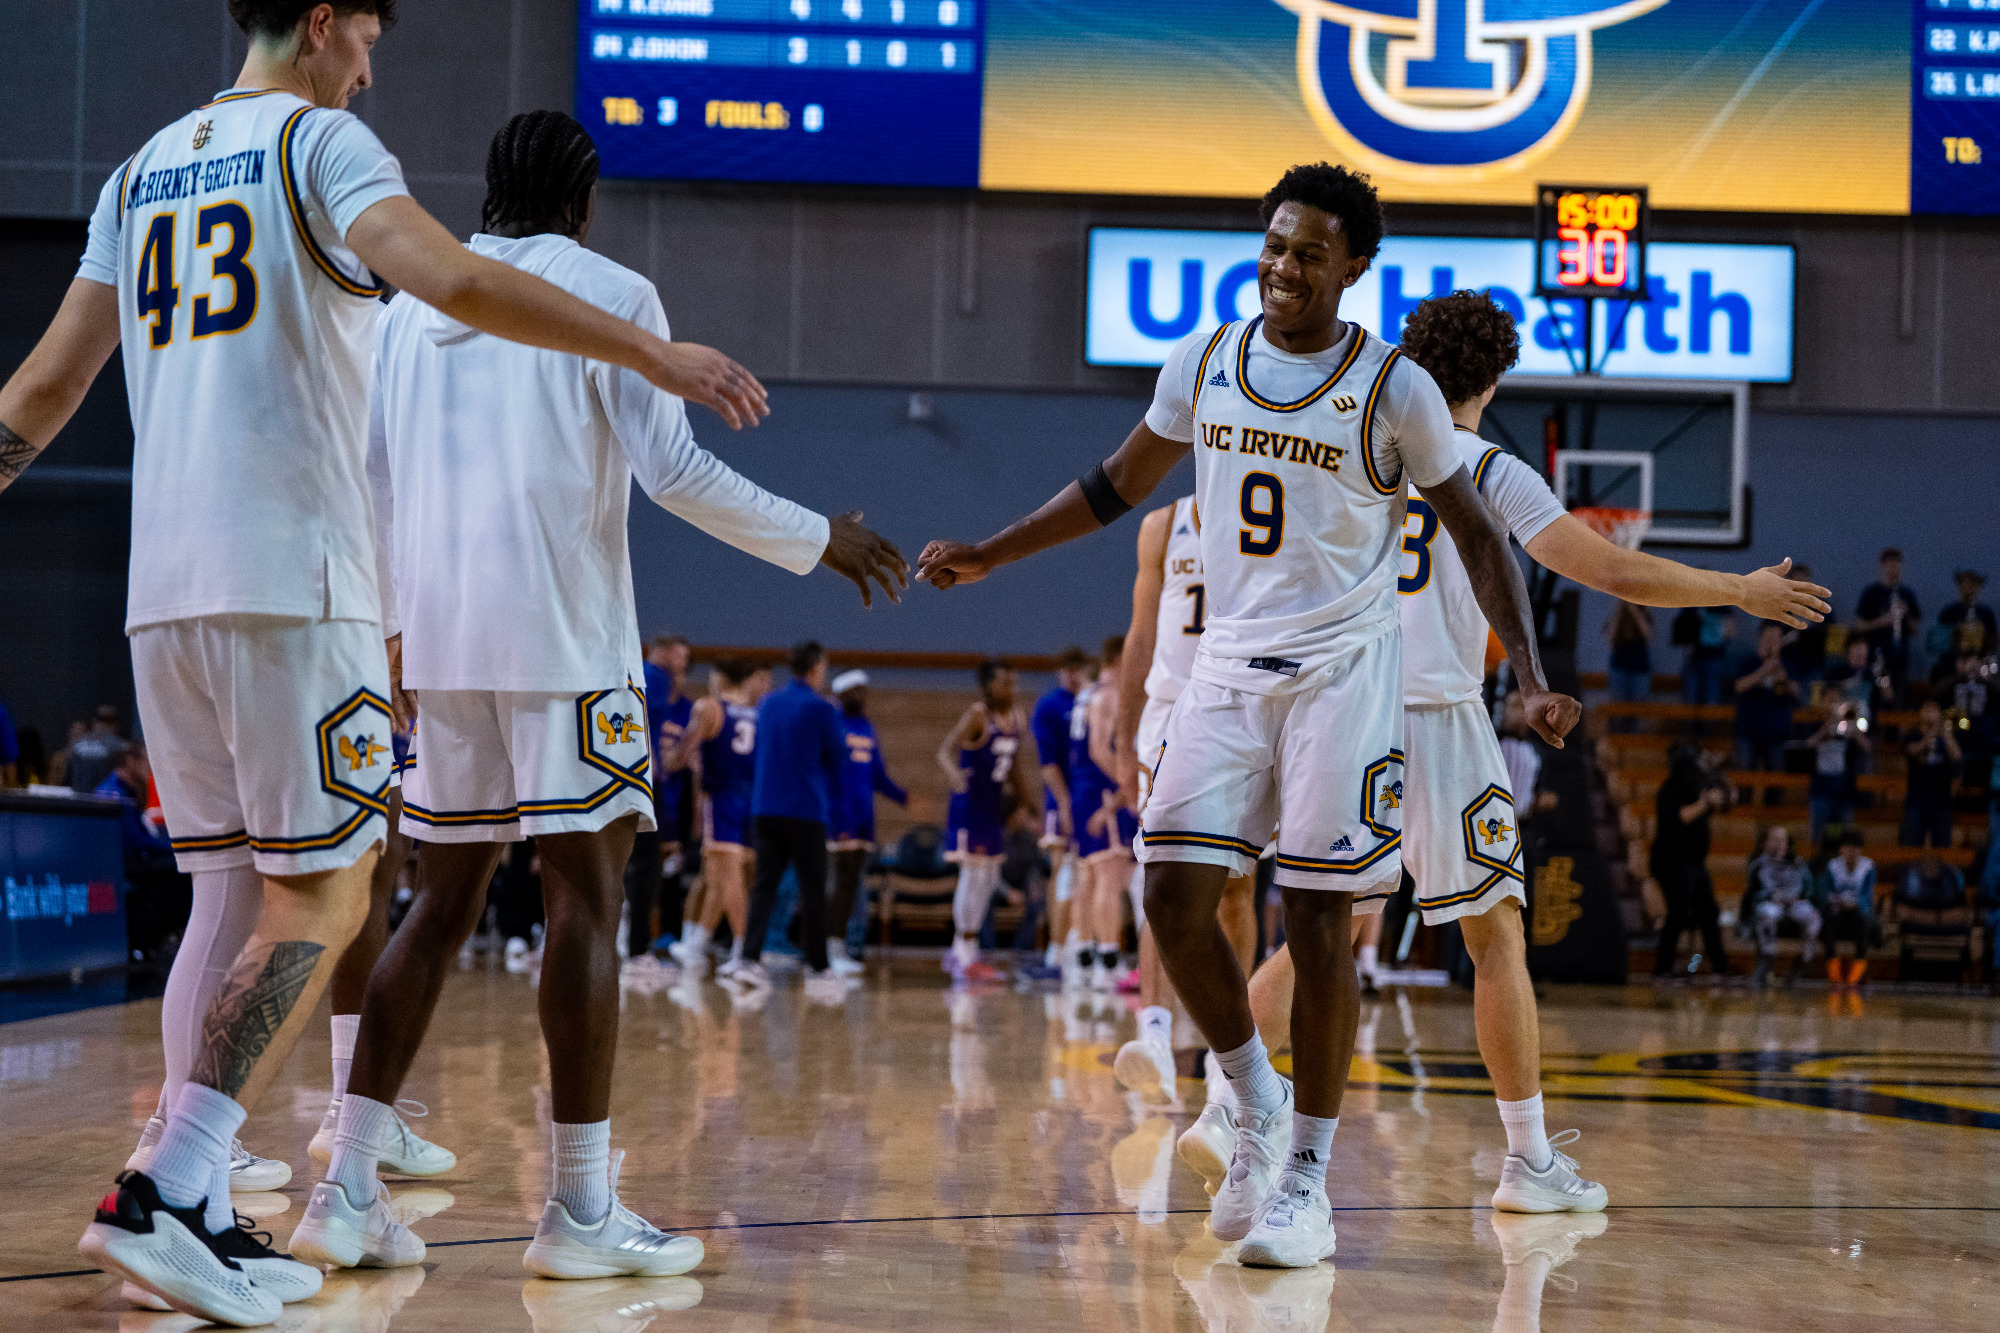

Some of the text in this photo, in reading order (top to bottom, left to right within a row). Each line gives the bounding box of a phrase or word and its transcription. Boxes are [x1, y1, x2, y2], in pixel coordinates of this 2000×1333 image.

[1557, 194, 1638, 230] 15:00
[137, 199, 260, 350] 43
[1557, 227, 1628, 286] 30
[1381, 265, 1752, 356] Halth
[1201, 422, 1345, 473] UC IRVINE
[1239, 470, 1285, 558] 9
